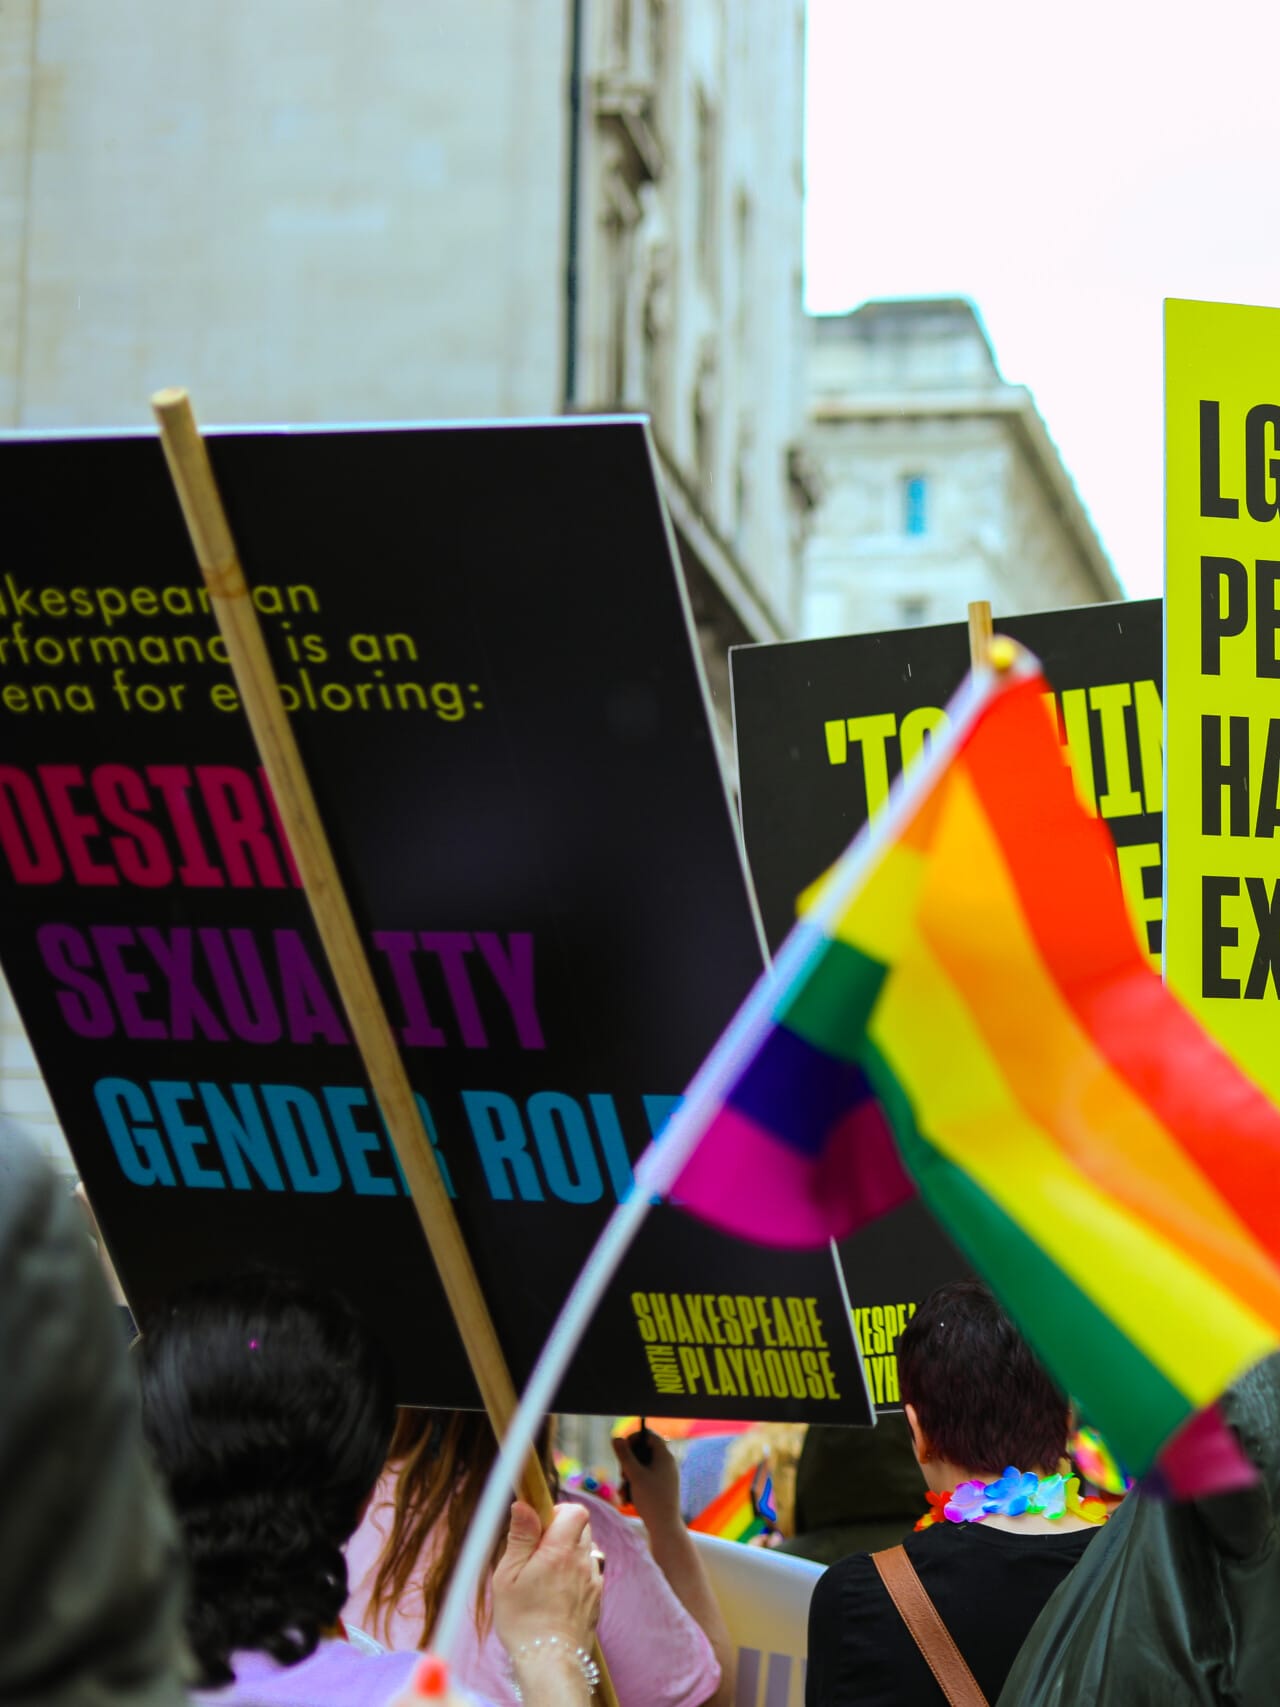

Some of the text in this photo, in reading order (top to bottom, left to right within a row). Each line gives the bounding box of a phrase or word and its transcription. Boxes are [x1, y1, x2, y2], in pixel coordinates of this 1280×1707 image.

[0, 573, 320, 626] kespearan
[0, 621, 418, 665] rformanc is an
[1, 668, 484, 721] ena for eloring:
[36, 924, 546, 1049] SEXUAITY
[631, 1292, 828, 1348] SHAKESPEARE
[645, 1344, 685, 1394] NORTH
[678, 1346, 841, 1400] PLAYHOUSE
